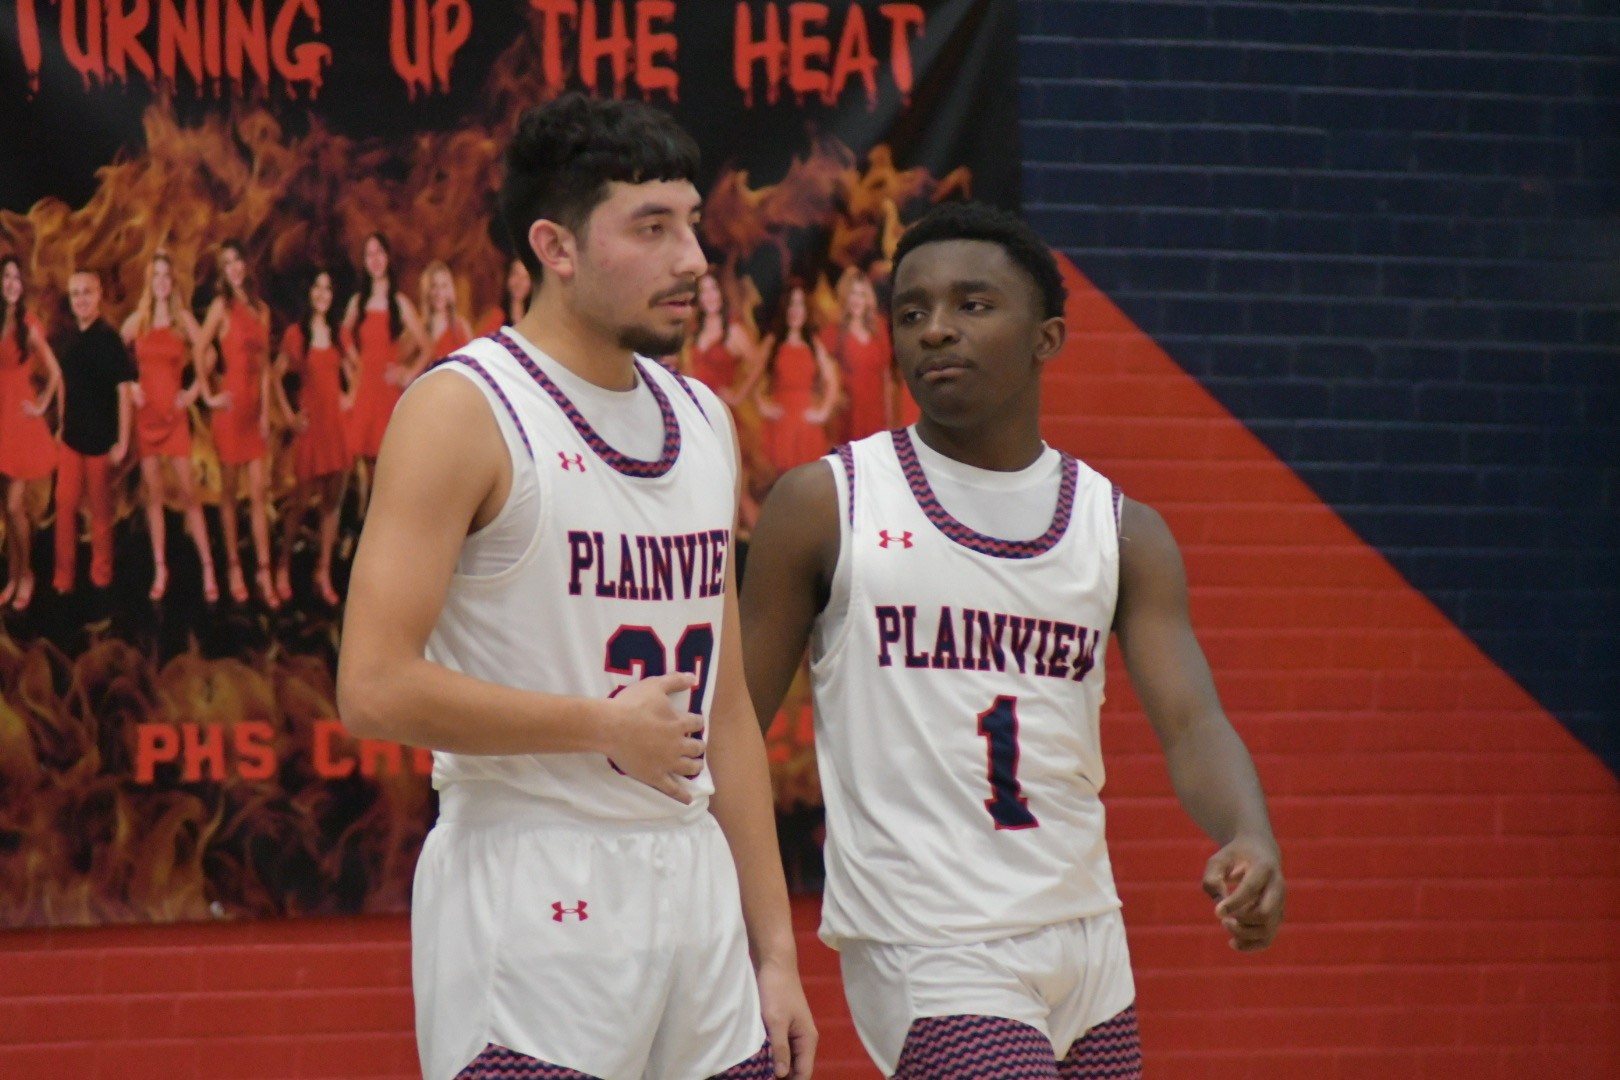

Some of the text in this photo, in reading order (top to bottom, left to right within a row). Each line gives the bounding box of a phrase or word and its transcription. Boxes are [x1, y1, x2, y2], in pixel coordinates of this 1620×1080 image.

[16, 0, 925, 110] TURNING UP THE HEAT
[567, 529, 729, 601] PLAINVIE
[875, 605, 1100, 682] PLAINVIEW
[136, 719, 278, 784] PHS
[977, 694, 1039, 830] 1
